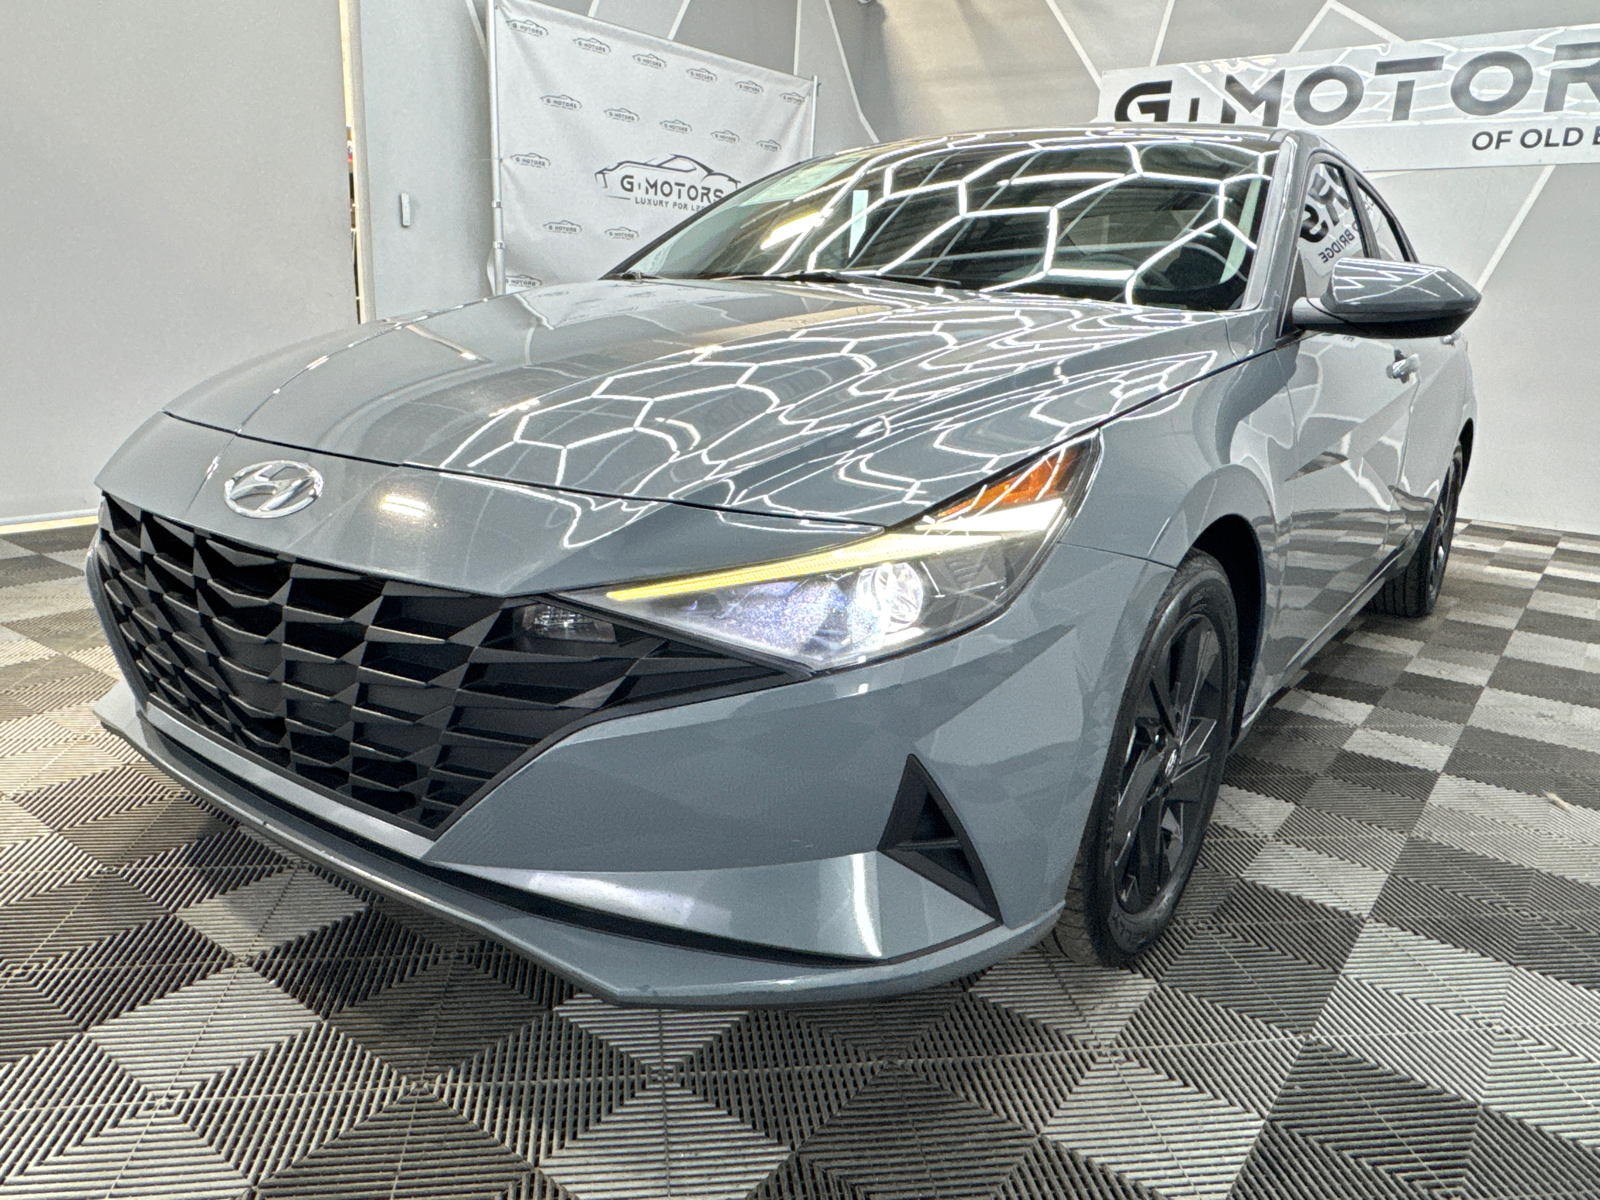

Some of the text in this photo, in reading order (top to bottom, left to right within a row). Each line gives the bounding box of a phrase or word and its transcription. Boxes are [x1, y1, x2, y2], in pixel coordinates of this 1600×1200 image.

[1471, 130, 1513, 151] OF
[1520, 127, 1584, 149] OLD
[635, 197, 669, 208] LUXURY
[672, 201, 688, 211] FOR
